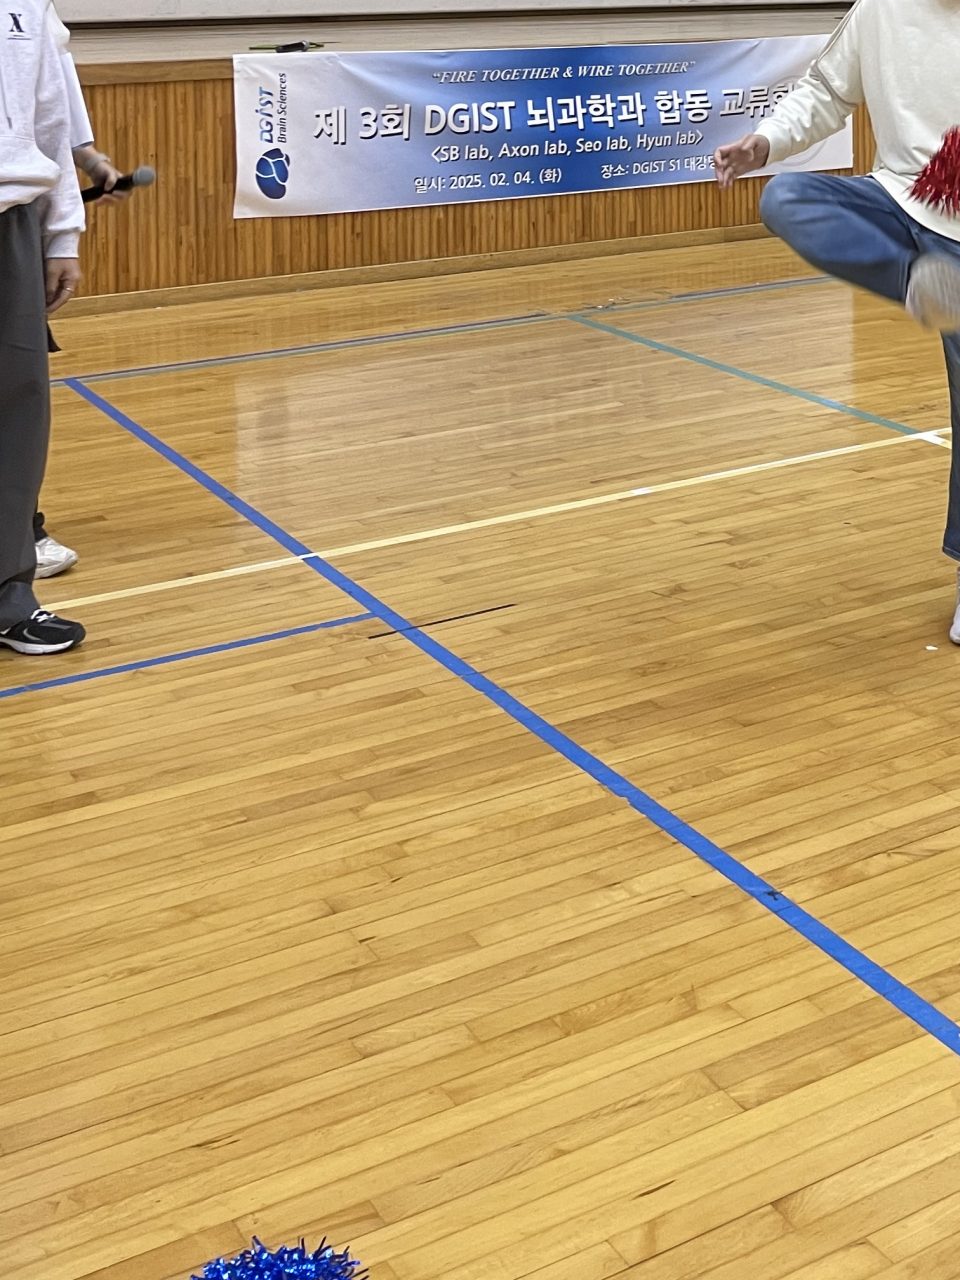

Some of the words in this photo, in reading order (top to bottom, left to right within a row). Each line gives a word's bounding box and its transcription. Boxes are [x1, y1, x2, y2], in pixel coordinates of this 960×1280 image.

[481, 67, 560, 82] TOGETHER
[563, 66, 573, 78] &
[578, 64, 614, 78] WIRE
[277, 73, 287, 115] Sciences
[277, 116, 287, 144] Brain
[313, 106, 347, 145] 제
[359, 103, 412, 141] 3회
[424, 101, 516, 135] DGIST
[526, 91, 647, 132] 뇌과학과
[654, 89, 713, 125] 합동
[464, 145, 493, 161] lab,
[499, 142, 540, 158] Axon
[544, 140, 571, 157] lab,
[576, 138, 602, 153] Seo
[606, 135, 632, 152] lab,
[636, 133, 672, 151] Hyun
[414, 176, 446, 193] 일시:
[449, 173, 486, 190] 2025.
[489, 172, 510, 187] 02.
[513, 171, 535, 185] 04.
[539, 168, 562, 184] (화)
[600, 164, 629, 179] 장소:
[632, 159, 667, 175] DGIST
[669, 159, 681, 171] S1
